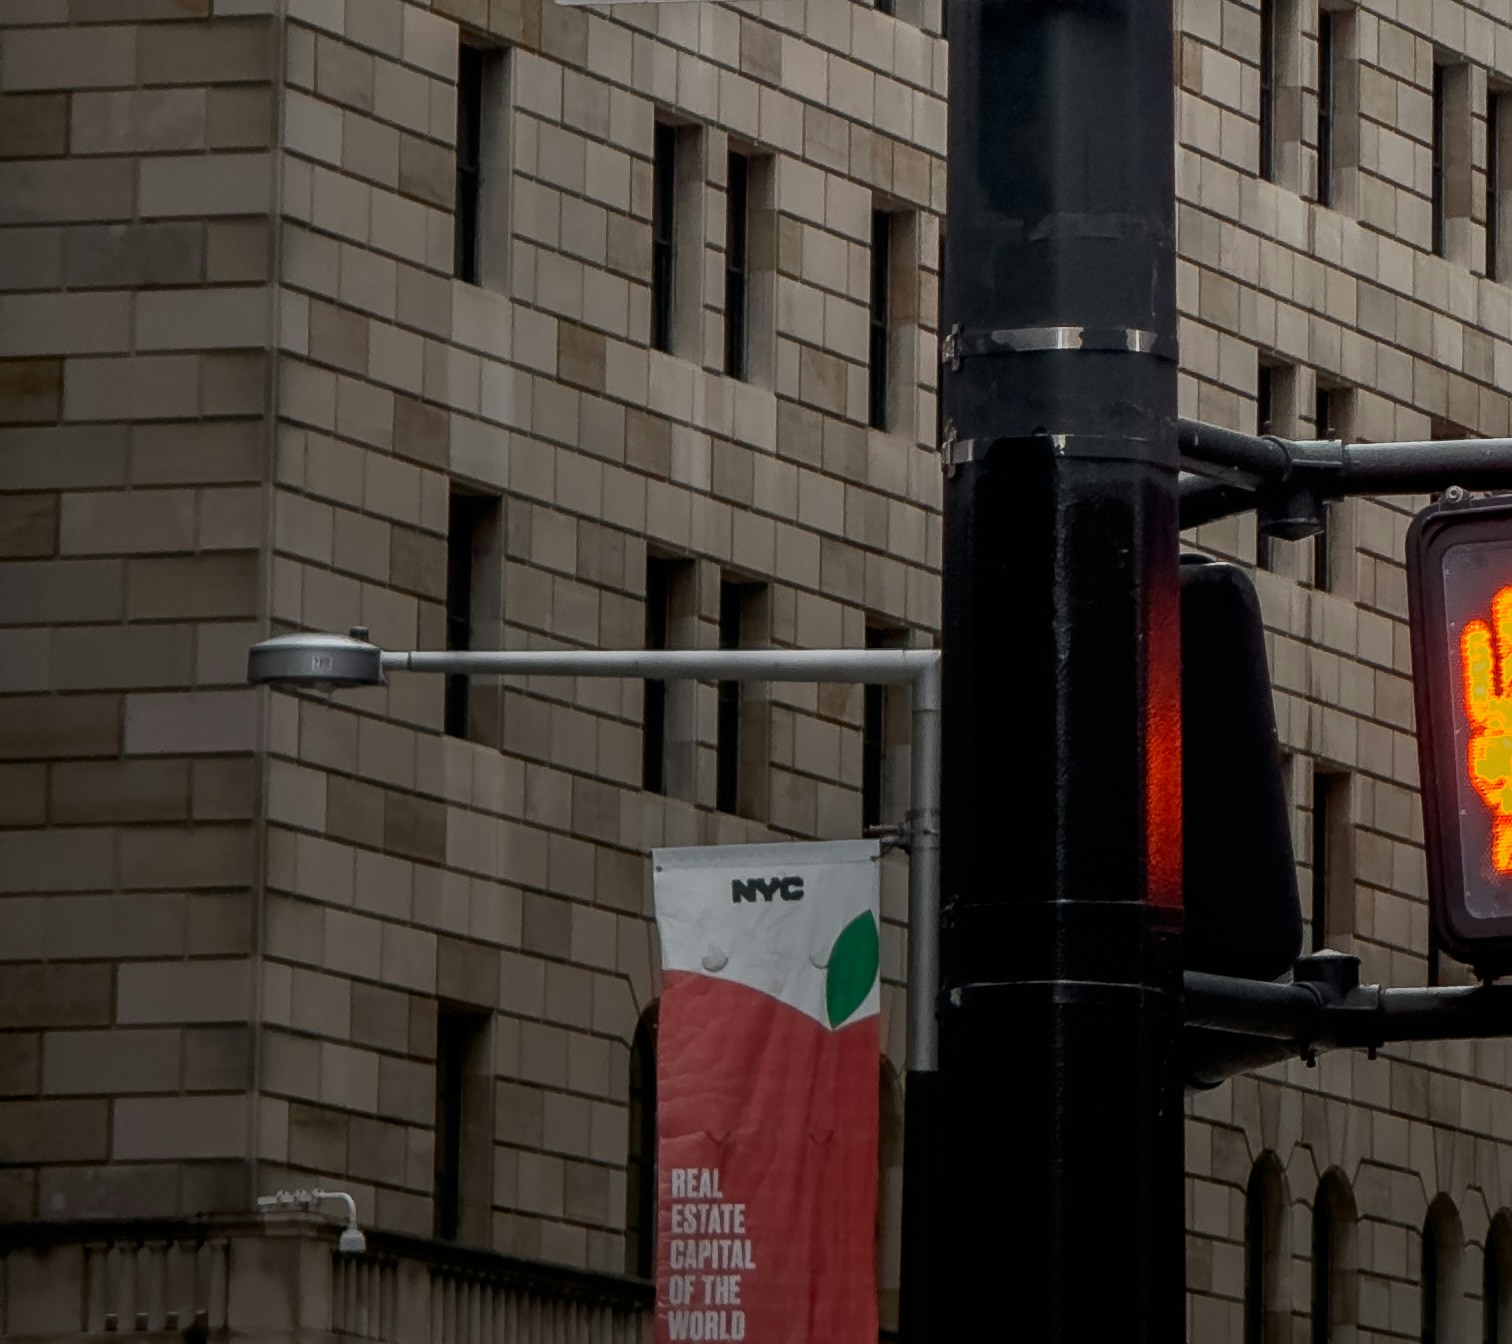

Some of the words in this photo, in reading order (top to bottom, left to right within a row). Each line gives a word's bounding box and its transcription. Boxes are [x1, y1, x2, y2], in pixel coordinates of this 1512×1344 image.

[731, 876, 805, 904] NYC
[672, 1168, 722, 1198] REAL
[672, 1204, 745, 1234] ESTATE
[670, 1239, 756, 1269] CAPITAL
[669, 1275, 696, 1305] OF
[702, 1275, 741, 1305] THE
[668, 1310, 745, 1340] WORLD
